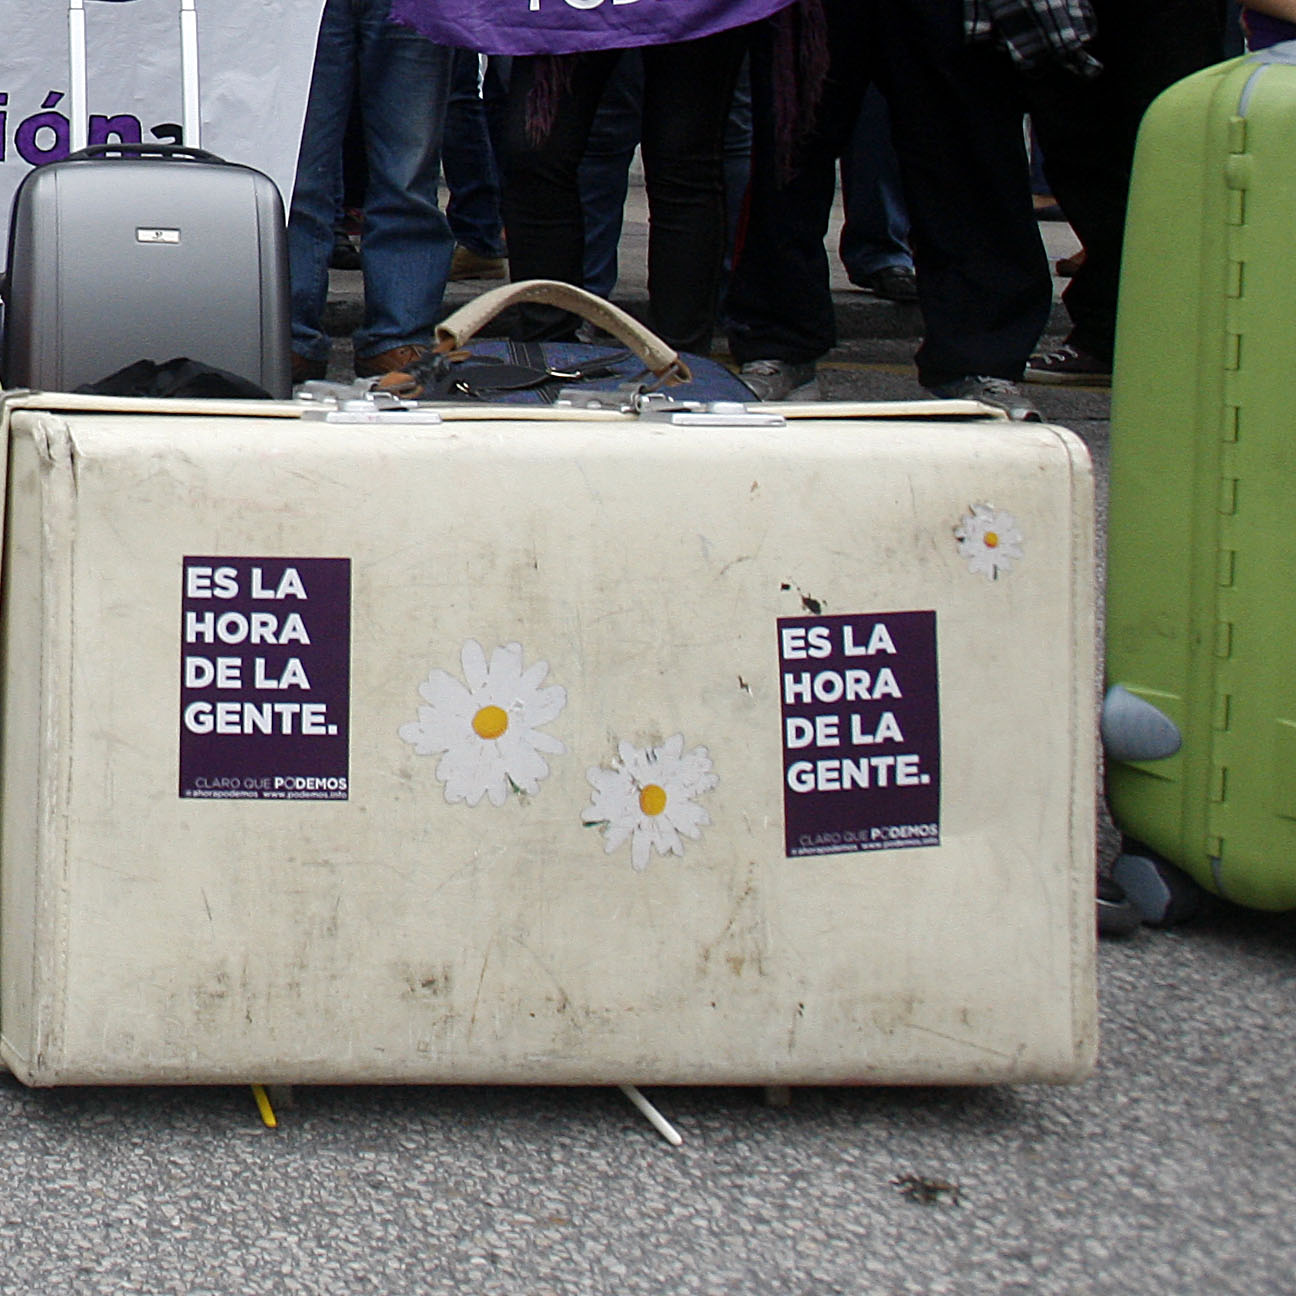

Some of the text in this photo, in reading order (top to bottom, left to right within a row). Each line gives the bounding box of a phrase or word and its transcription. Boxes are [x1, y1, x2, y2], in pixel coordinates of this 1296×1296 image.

[187, 566, 308, 600] ES LA
[185, 611, 311, 645] HORA
[781, 622, 897, 660] ES LA
[184, 656, 311, 690] DE LA
[783, 667, 903, 704] HORA
[184, 701, 338, 735] GENTE.
[786, 711, 904, 749] DE LA
[195, 776, 348, 791] CLARO QUE PODEMOS
[787, 754, 931, 793] GENTE.
[870, 823, 938, 840] PODEMOS
